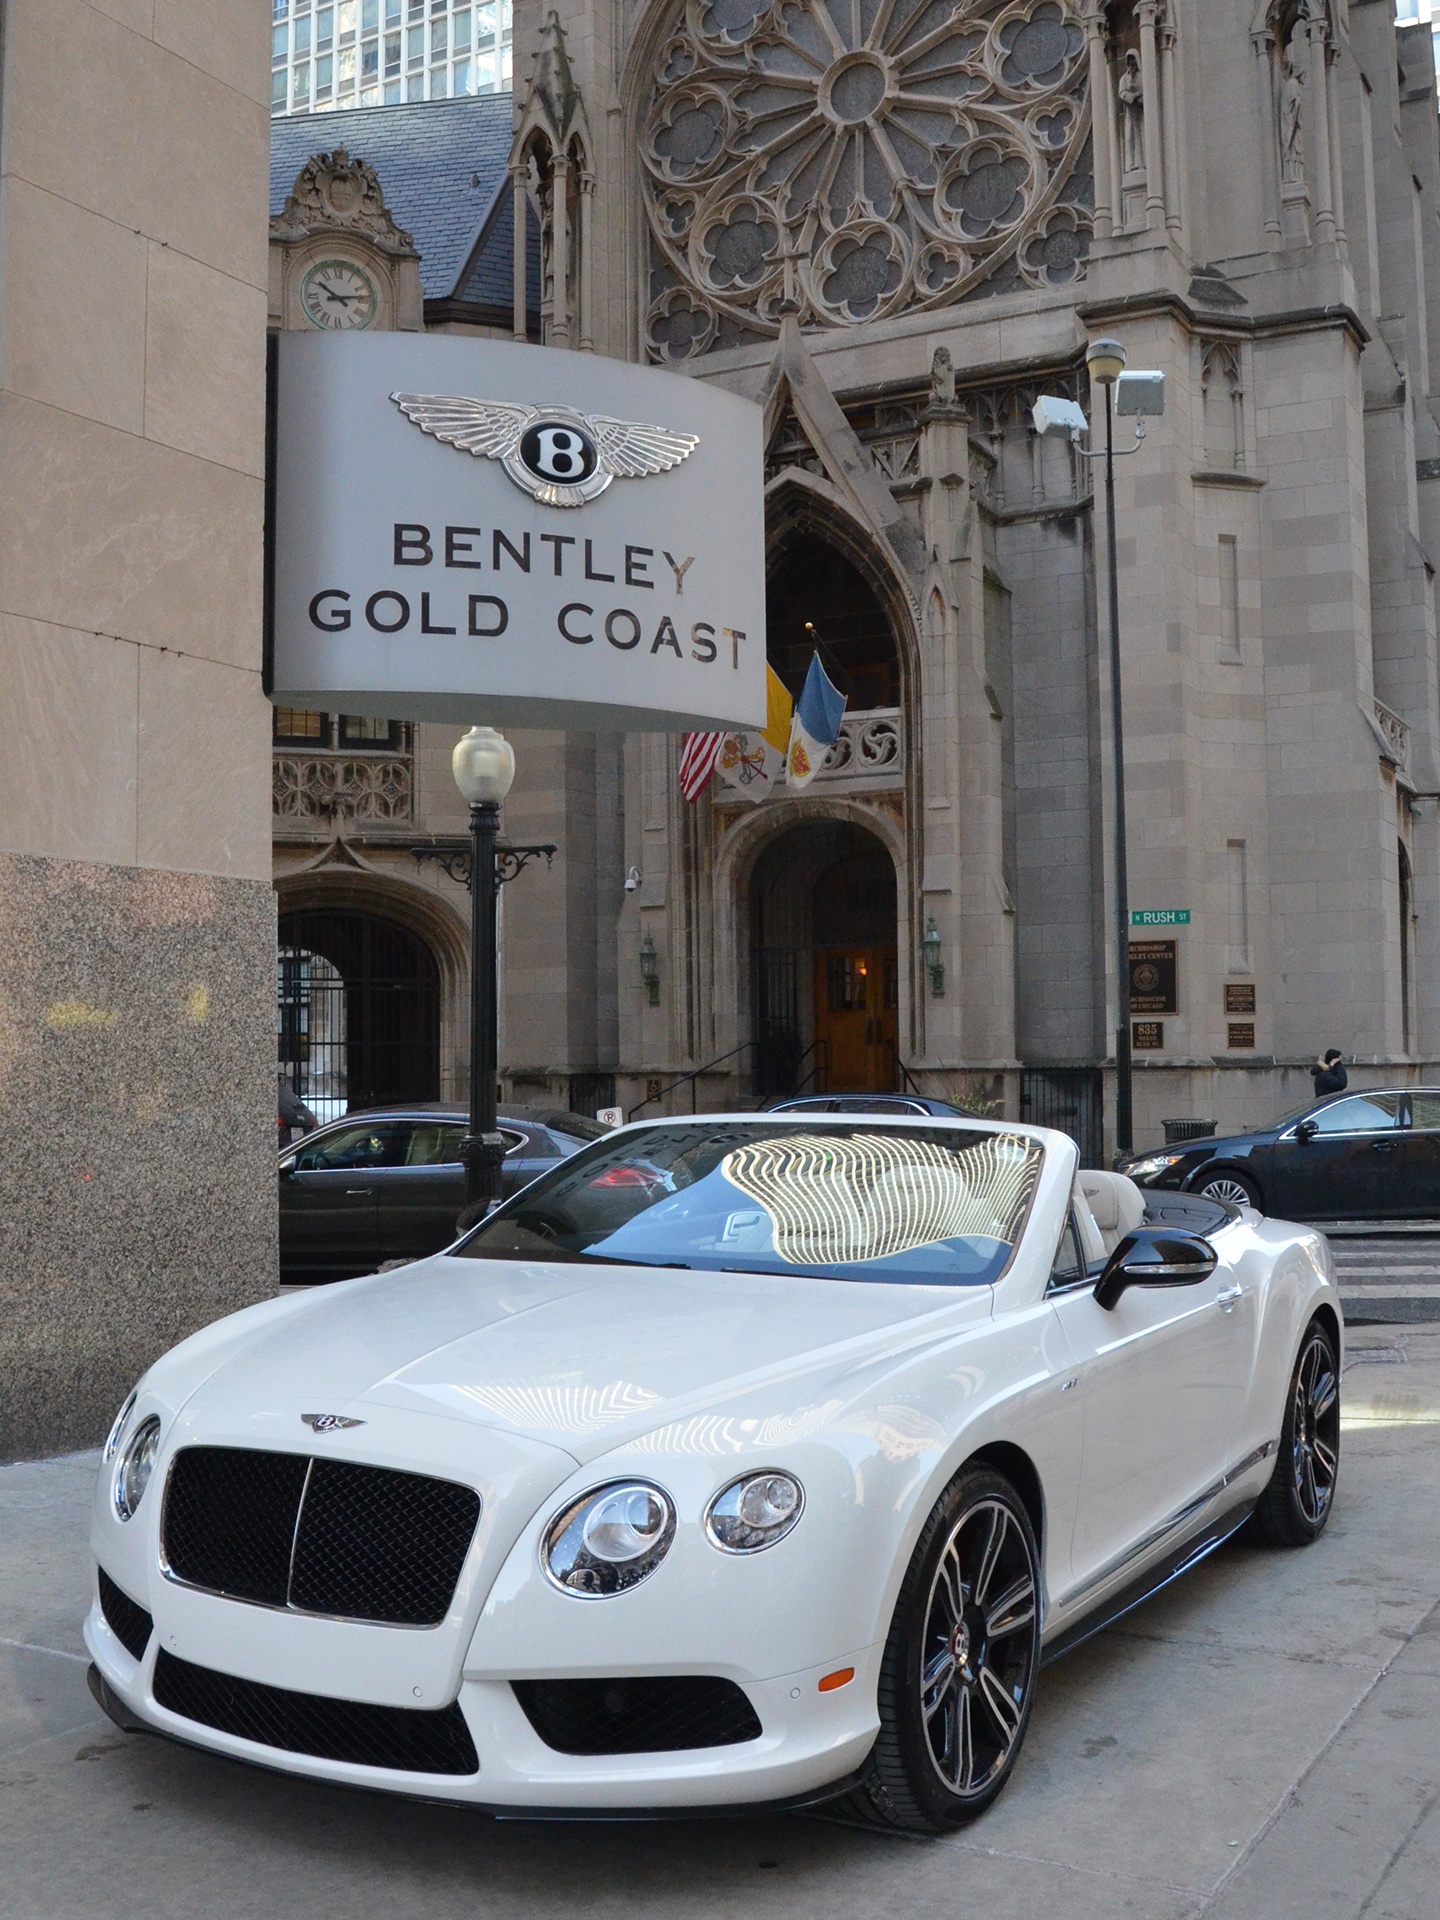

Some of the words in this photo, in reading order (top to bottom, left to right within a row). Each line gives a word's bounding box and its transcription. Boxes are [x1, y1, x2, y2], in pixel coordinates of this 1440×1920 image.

[536, 427, 585, 479] B
[393, 523, 696, 596] BENTLEY
[308, 588, 509, 638] GOLD
[557, 602, 747, 670] COAST
[1143, 911, 1176, 924] RUSH
[1179, 913, 1188, 921] ST
[1147, 952, 1174, 960] CENTER
[1137, 1024, 1158, 1036] 835
